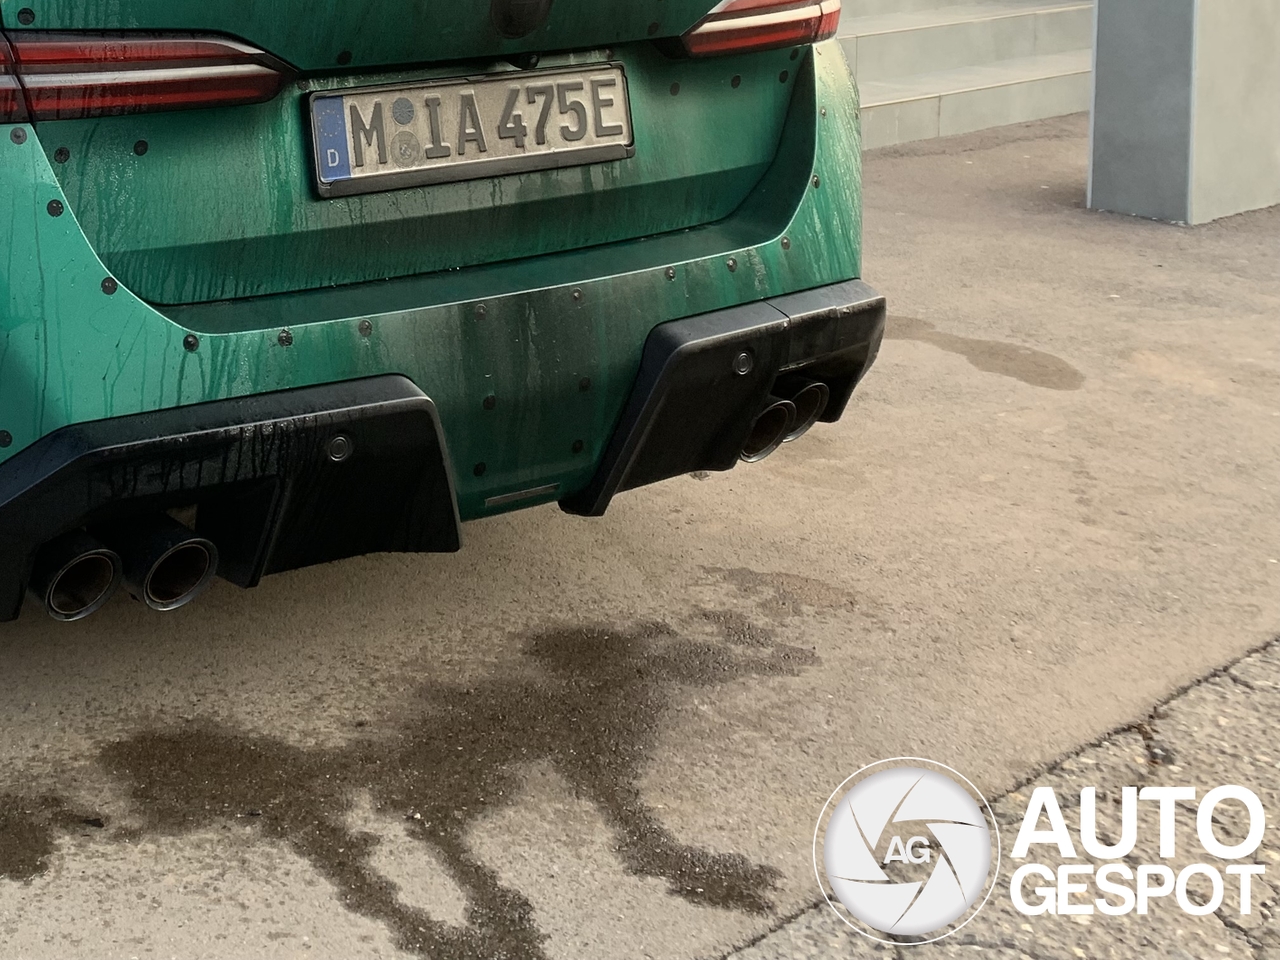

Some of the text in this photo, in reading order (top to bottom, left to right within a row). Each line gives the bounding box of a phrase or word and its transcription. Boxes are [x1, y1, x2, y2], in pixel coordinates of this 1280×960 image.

[326, 148, 340, 168] D
[349, 99, 388, 167] M
[497, 74, 624, 149] 475E
